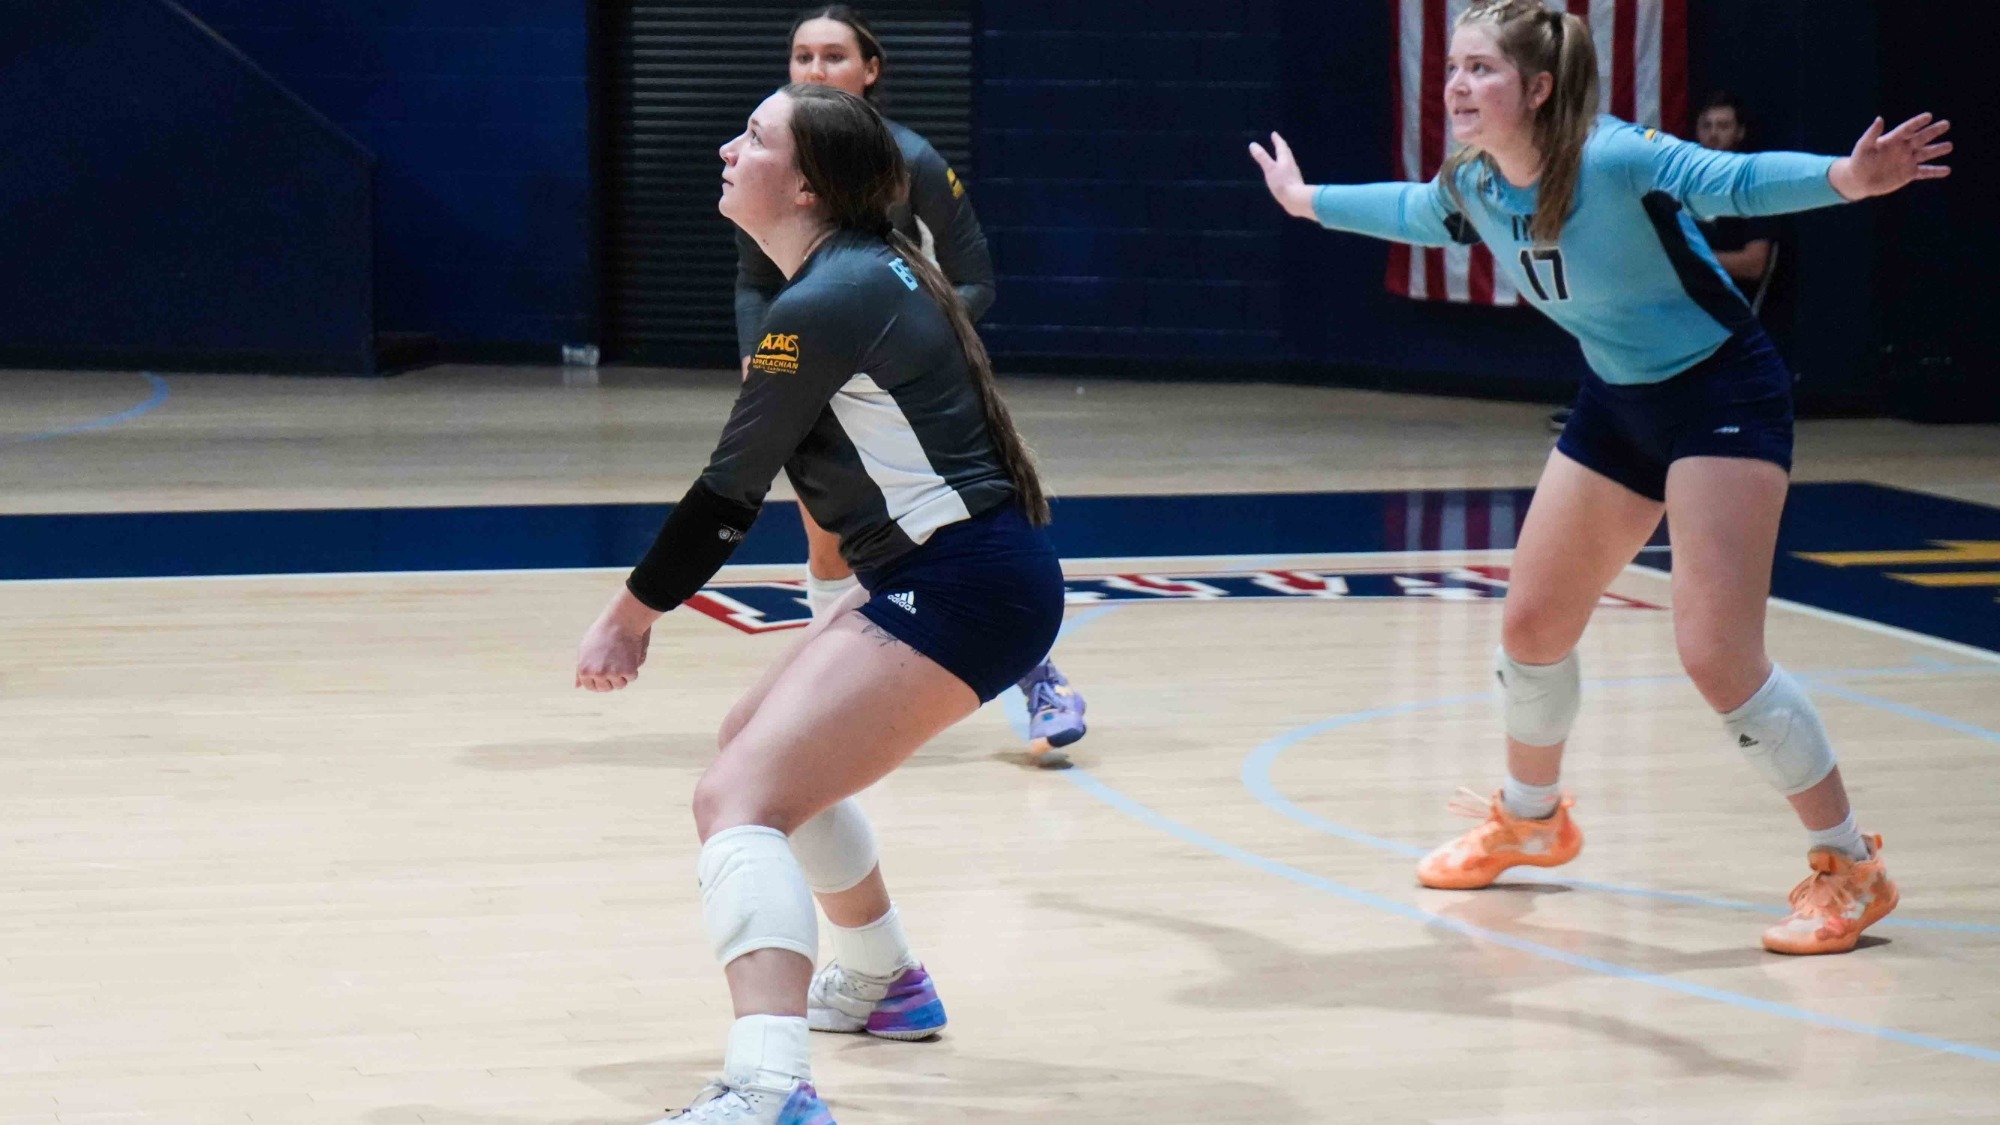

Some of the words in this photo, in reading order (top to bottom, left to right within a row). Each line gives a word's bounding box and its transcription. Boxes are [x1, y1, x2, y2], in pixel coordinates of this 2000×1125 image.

[1519, 248, 1570, 301] 17
[761, 333, 799, 352] AAC
[887, 594, 917, 614] adidas
